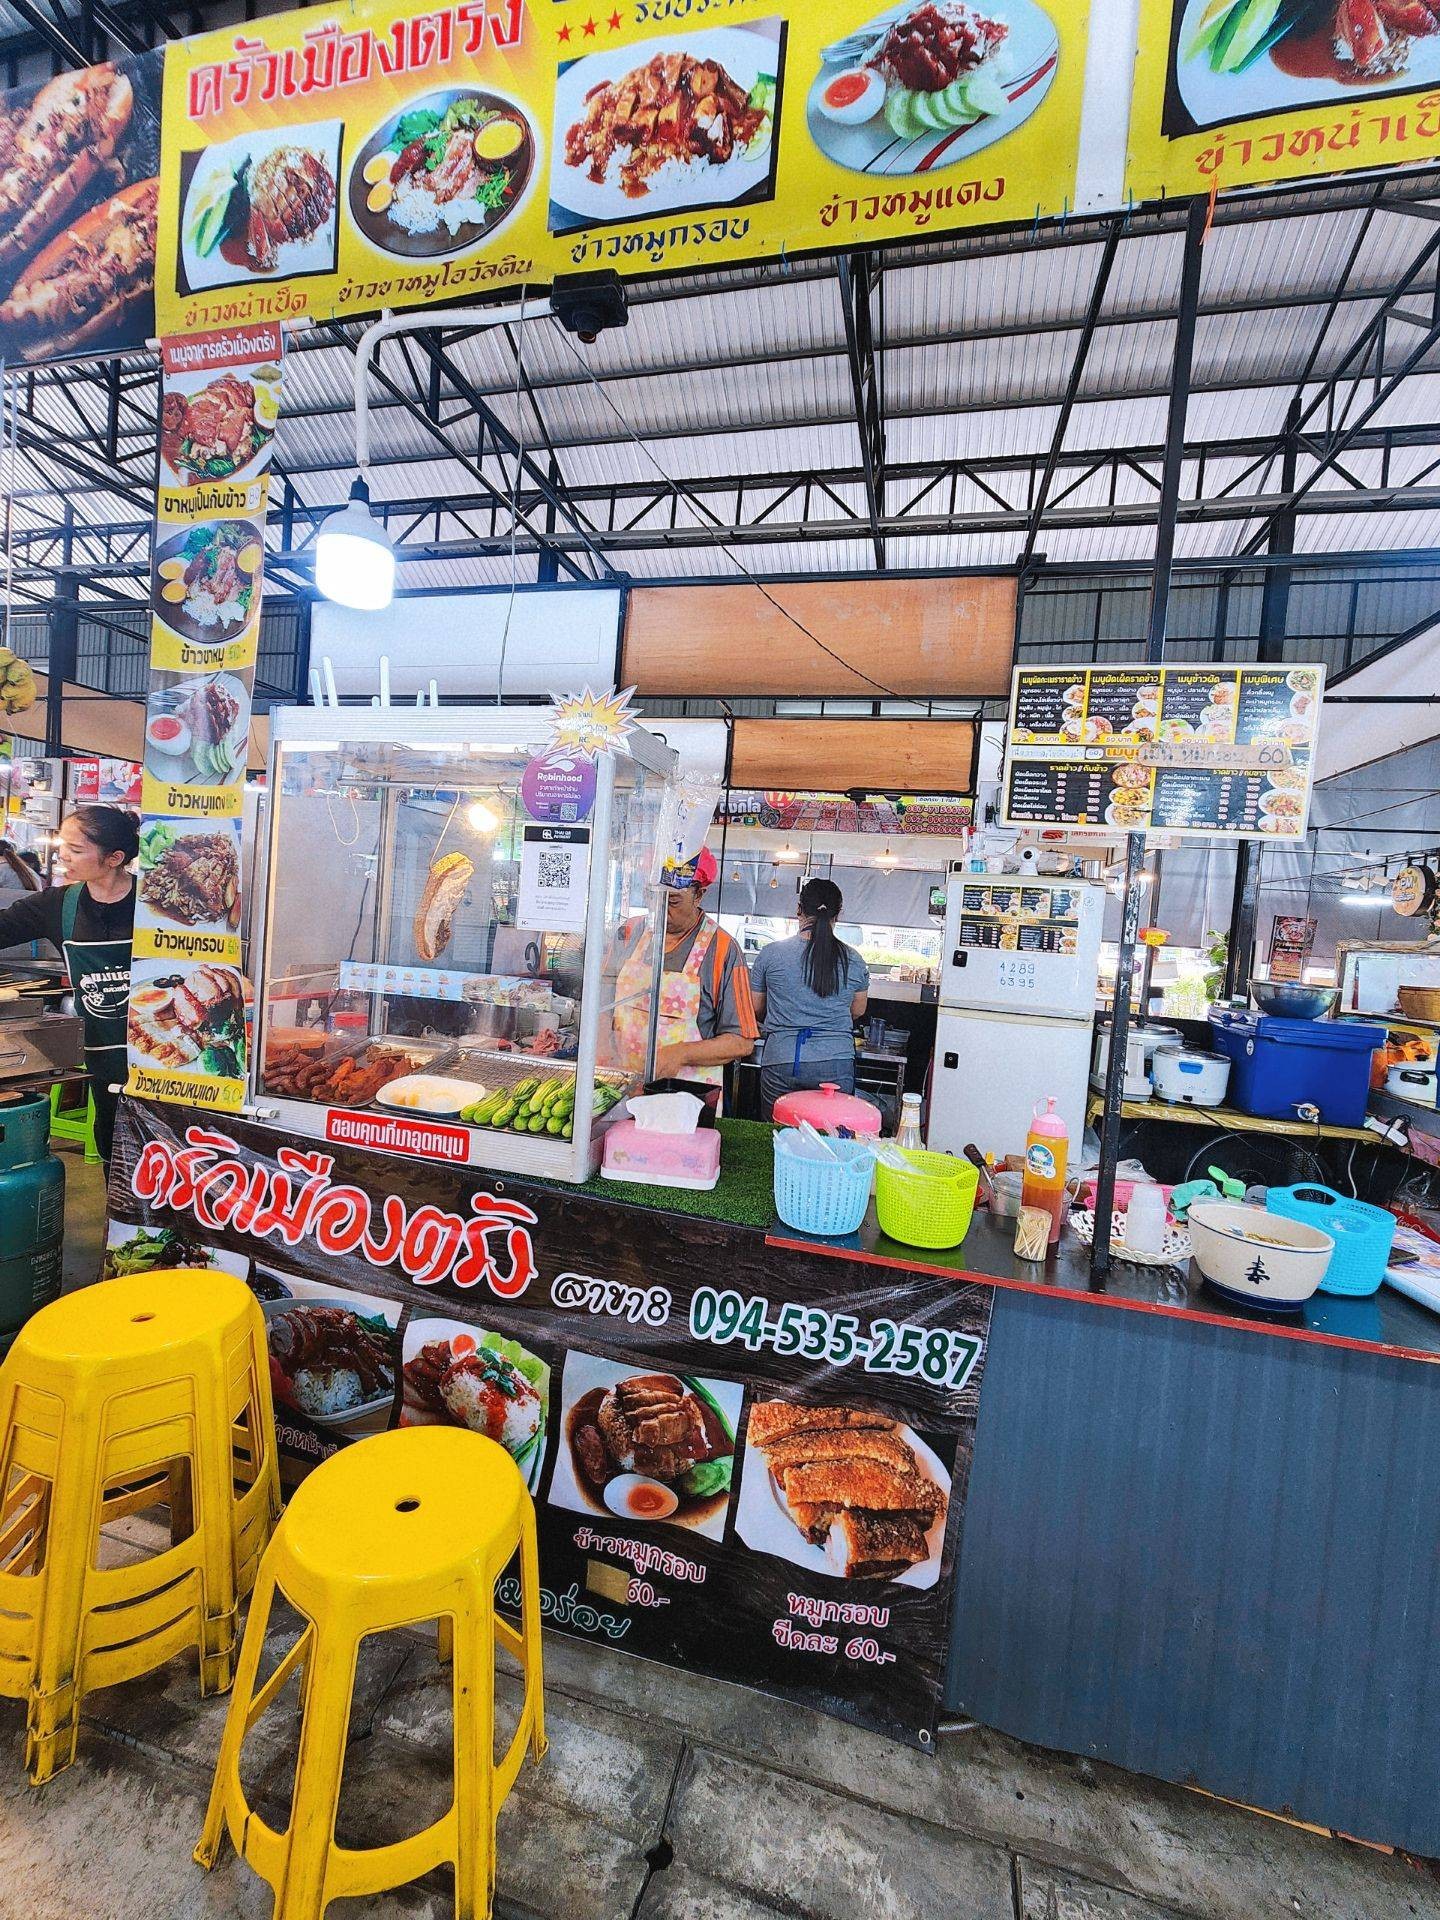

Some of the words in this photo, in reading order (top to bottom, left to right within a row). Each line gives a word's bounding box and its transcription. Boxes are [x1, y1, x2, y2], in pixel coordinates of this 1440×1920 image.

[820, 177, 1005, 226] ข้าวหมูแดง
[571, 216, 751, 263] ข้าวหมูกรอบ
[185, 285, 308, 327] ข้าวหน้าเป็ด
[165, 487, 246, 519] ขาหมูเป็นกับข้าว
[181, 643, 225, 668] ข้าวขาหมู
[1258, 746, 1284, 763] 60
[537, 772, 583, 783] Robinhood
[168, 786, 226, 816] ข้าวหมูแดง
[154, 928, 225, 957] ข้าวหมูกรอบ
[331, 1117, 464, 1158] ขอบคุณที่มาอุดหนุน
[132, 1125, 538, 1299] ครัวเมืองตรัง
[690, 1286, 982, 1389] 094-535-2587
[573, 1527, 706, 1583] ข้าวหมูกรอบ
[787, 1592, 890, 1628] หมูกรอบ
[772, 1619, 839, 1654] ขีดละ
[845, 1637, 897, 1665] 60.-
